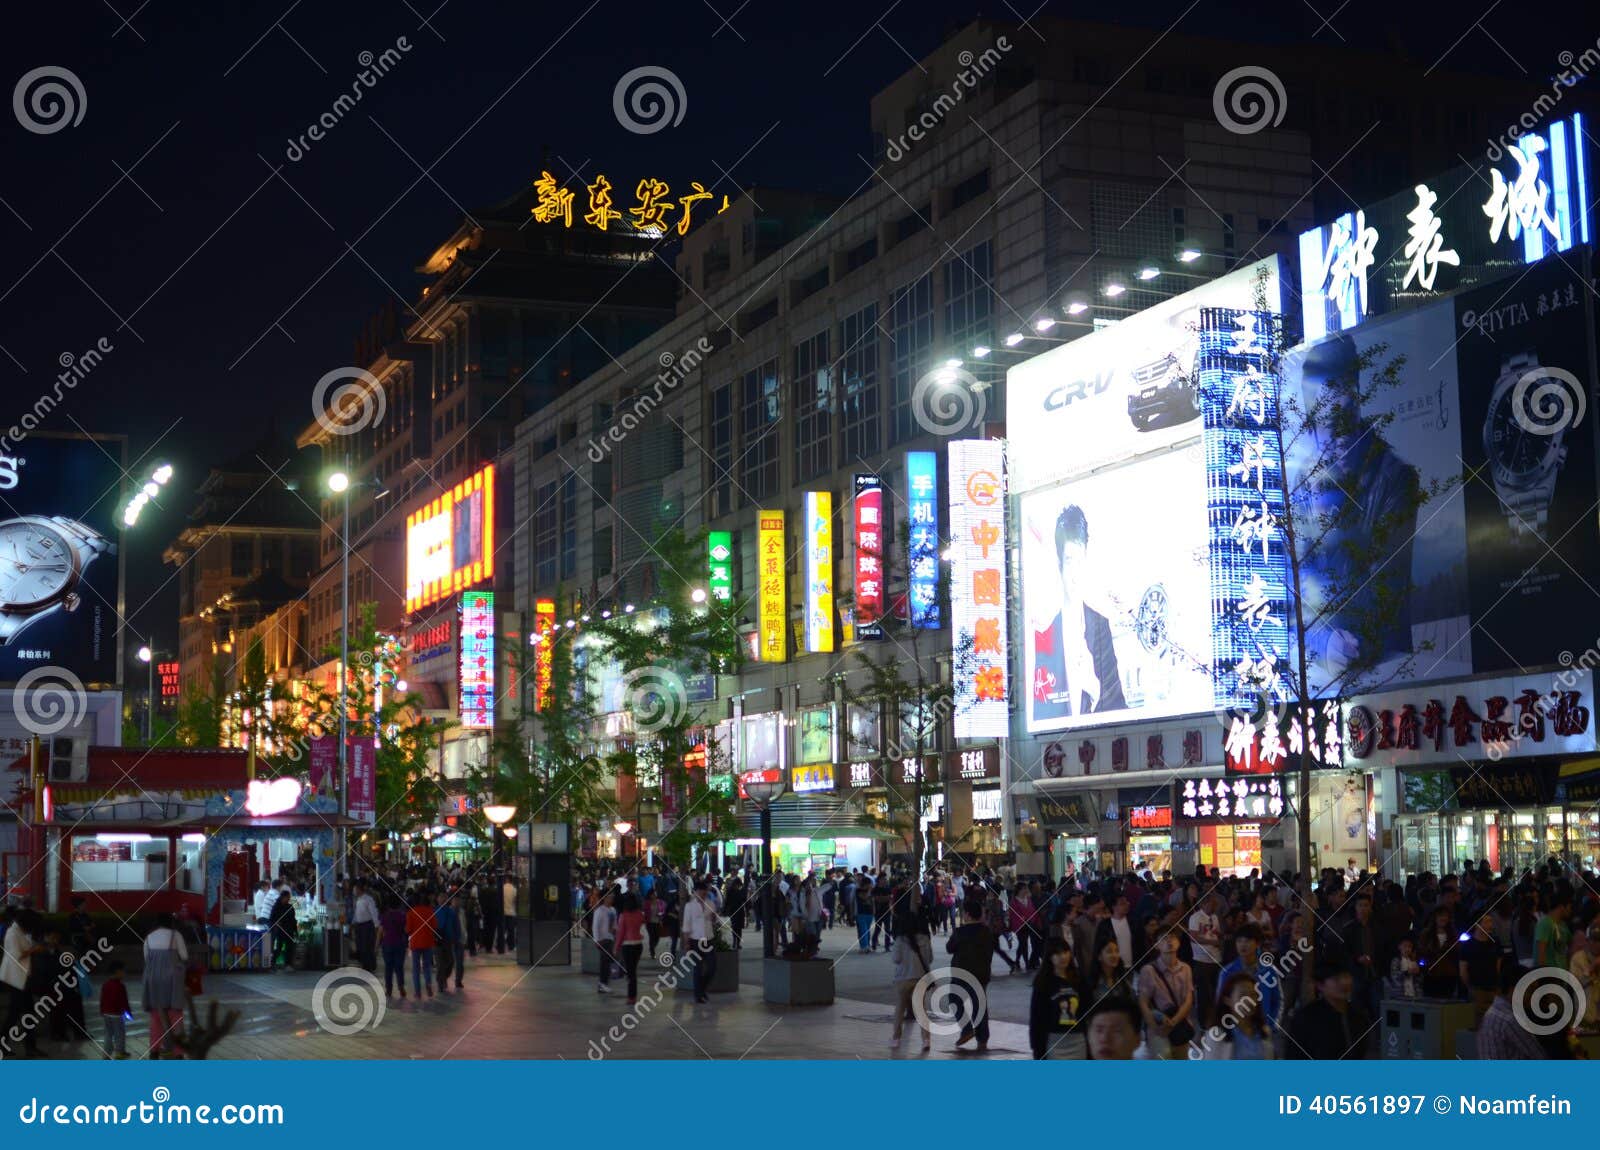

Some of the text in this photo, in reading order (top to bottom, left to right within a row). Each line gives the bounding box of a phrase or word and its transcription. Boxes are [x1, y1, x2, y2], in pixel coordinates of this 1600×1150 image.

[532, 171, 729, 235] 新东安广
[860, 507, 878, 597] 国际珠宝
